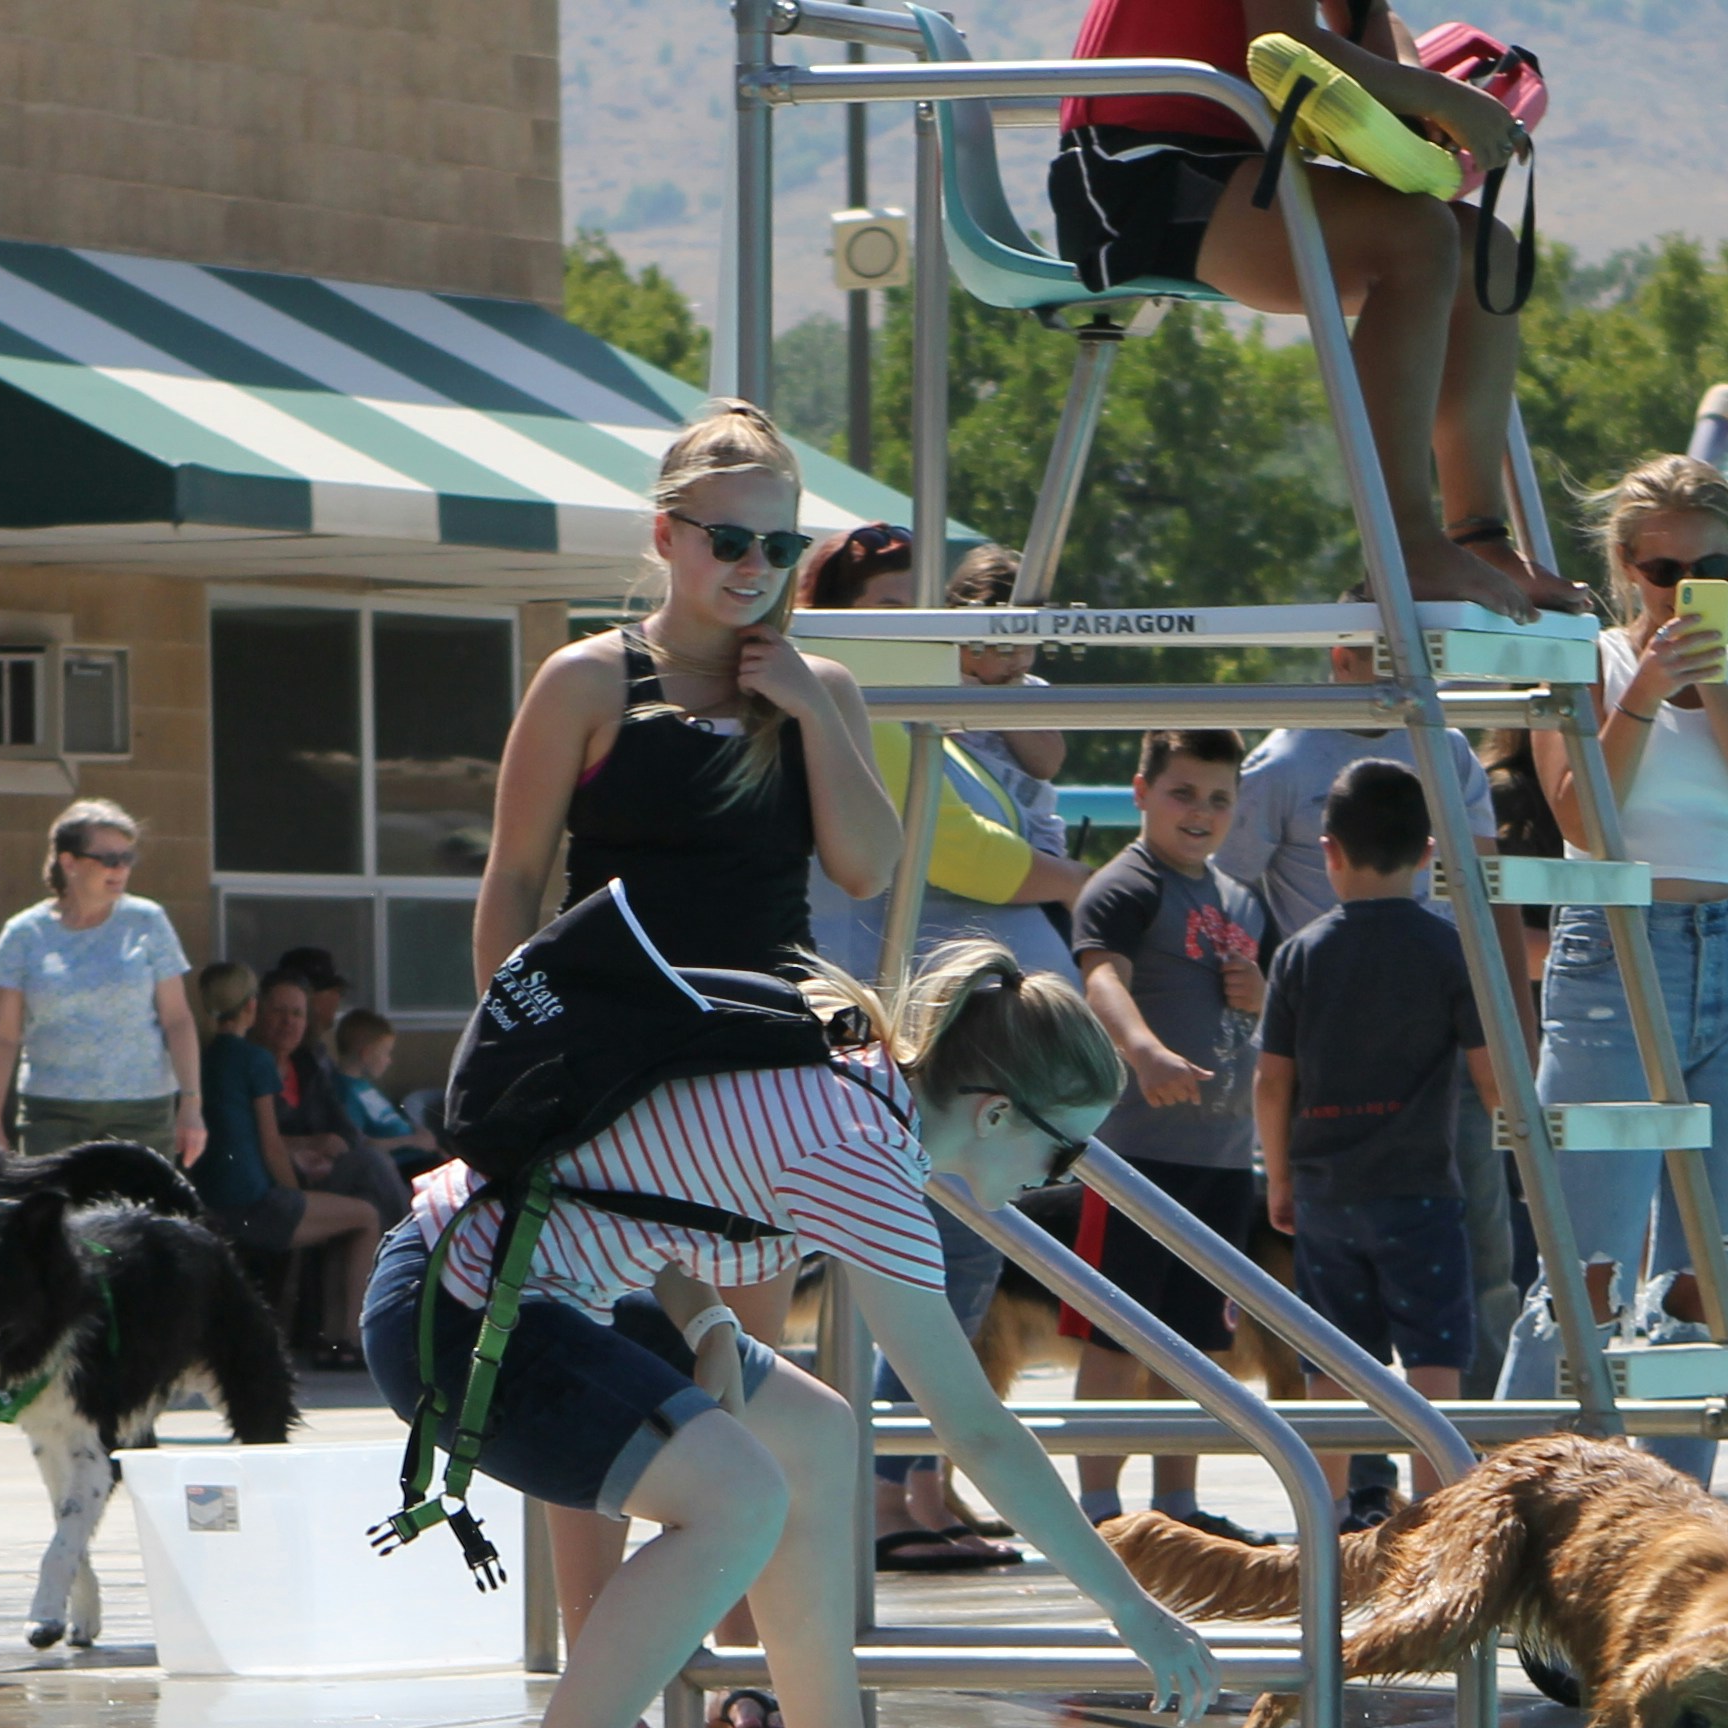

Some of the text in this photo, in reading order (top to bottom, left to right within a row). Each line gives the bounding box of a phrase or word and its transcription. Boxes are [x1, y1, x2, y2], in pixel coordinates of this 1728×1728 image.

[990, 614, 1195, 634] KDI PARAGON
[493, 969, 549, 1025] ERSITY
[521, 970, 565, 1017] State
[487, 998, 520, 1031] School
